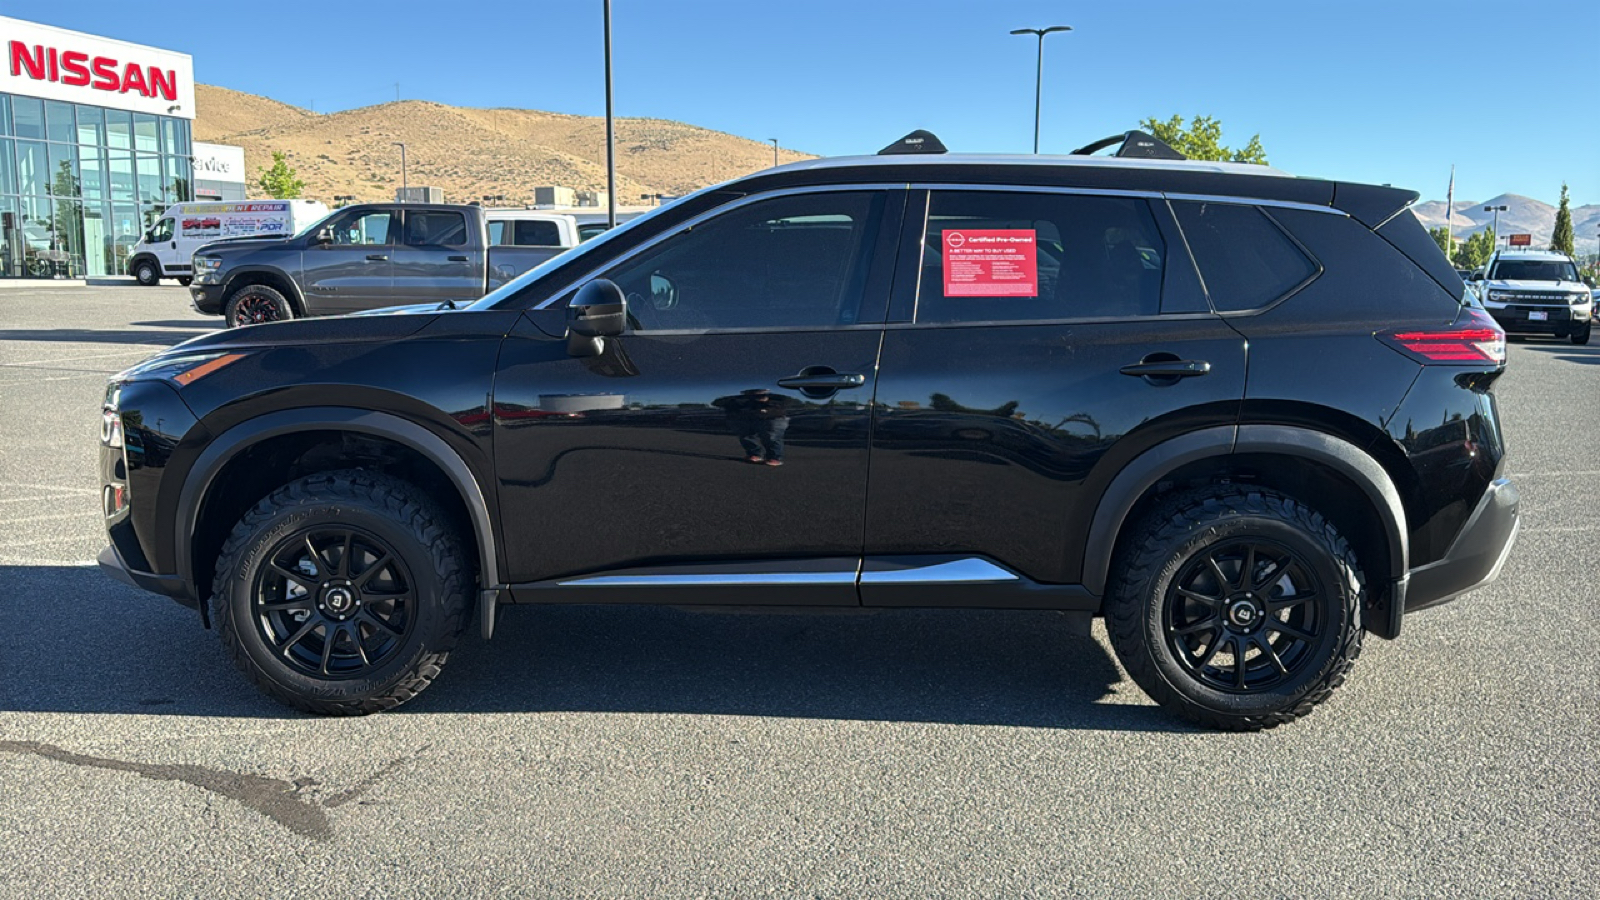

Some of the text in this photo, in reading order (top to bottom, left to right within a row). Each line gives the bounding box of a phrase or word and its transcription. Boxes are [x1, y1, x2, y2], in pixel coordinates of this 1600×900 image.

[9, 40, 177, 101] NISSAN
[193, 156, 230, 173] ervice
[250, 203, 283, 212] REPAIR
[260, 223, 283, 231] PDR
